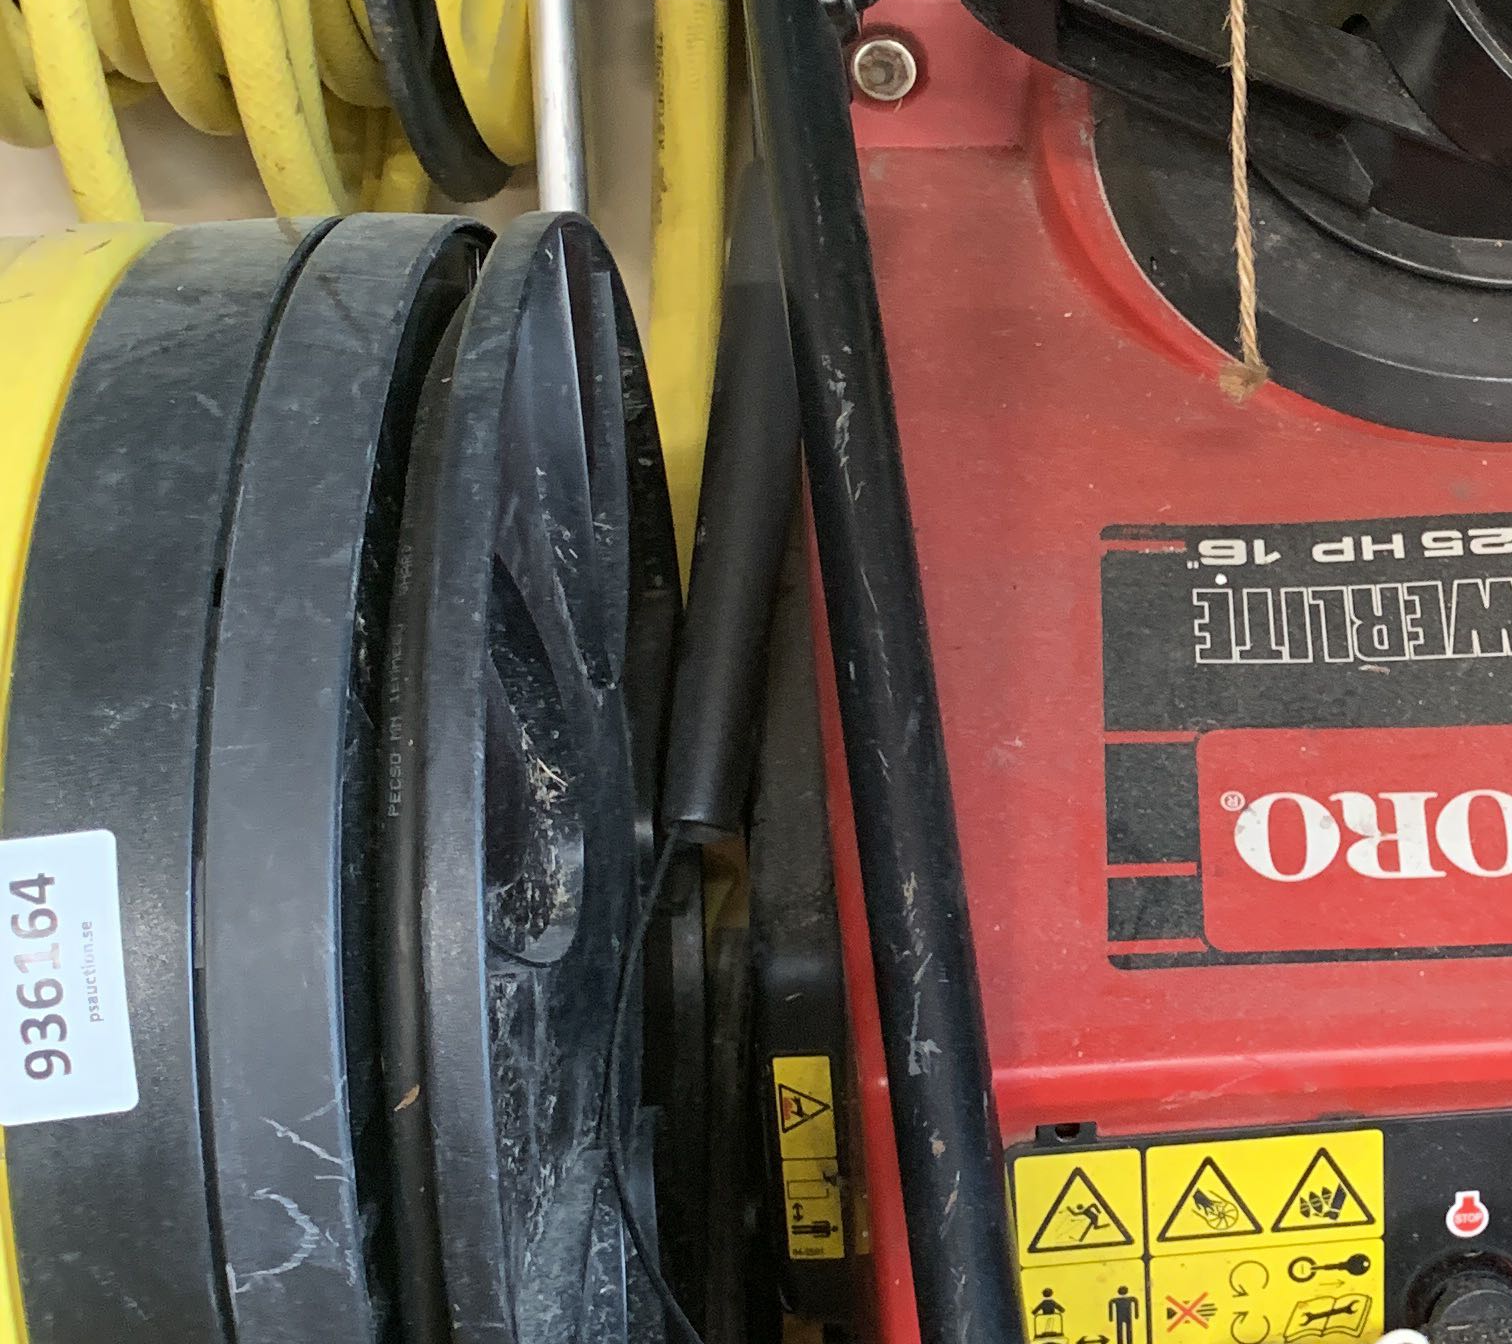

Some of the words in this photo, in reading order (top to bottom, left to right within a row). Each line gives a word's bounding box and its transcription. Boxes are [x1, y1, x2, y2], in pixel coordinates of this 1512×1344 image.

[1312, 534, 1406, 565] HP
[8, 872, 72, 1081] 936164
[81, 920, 104, 1023] psauction.se
[1454, 1212, 1484, 1225] STOP
